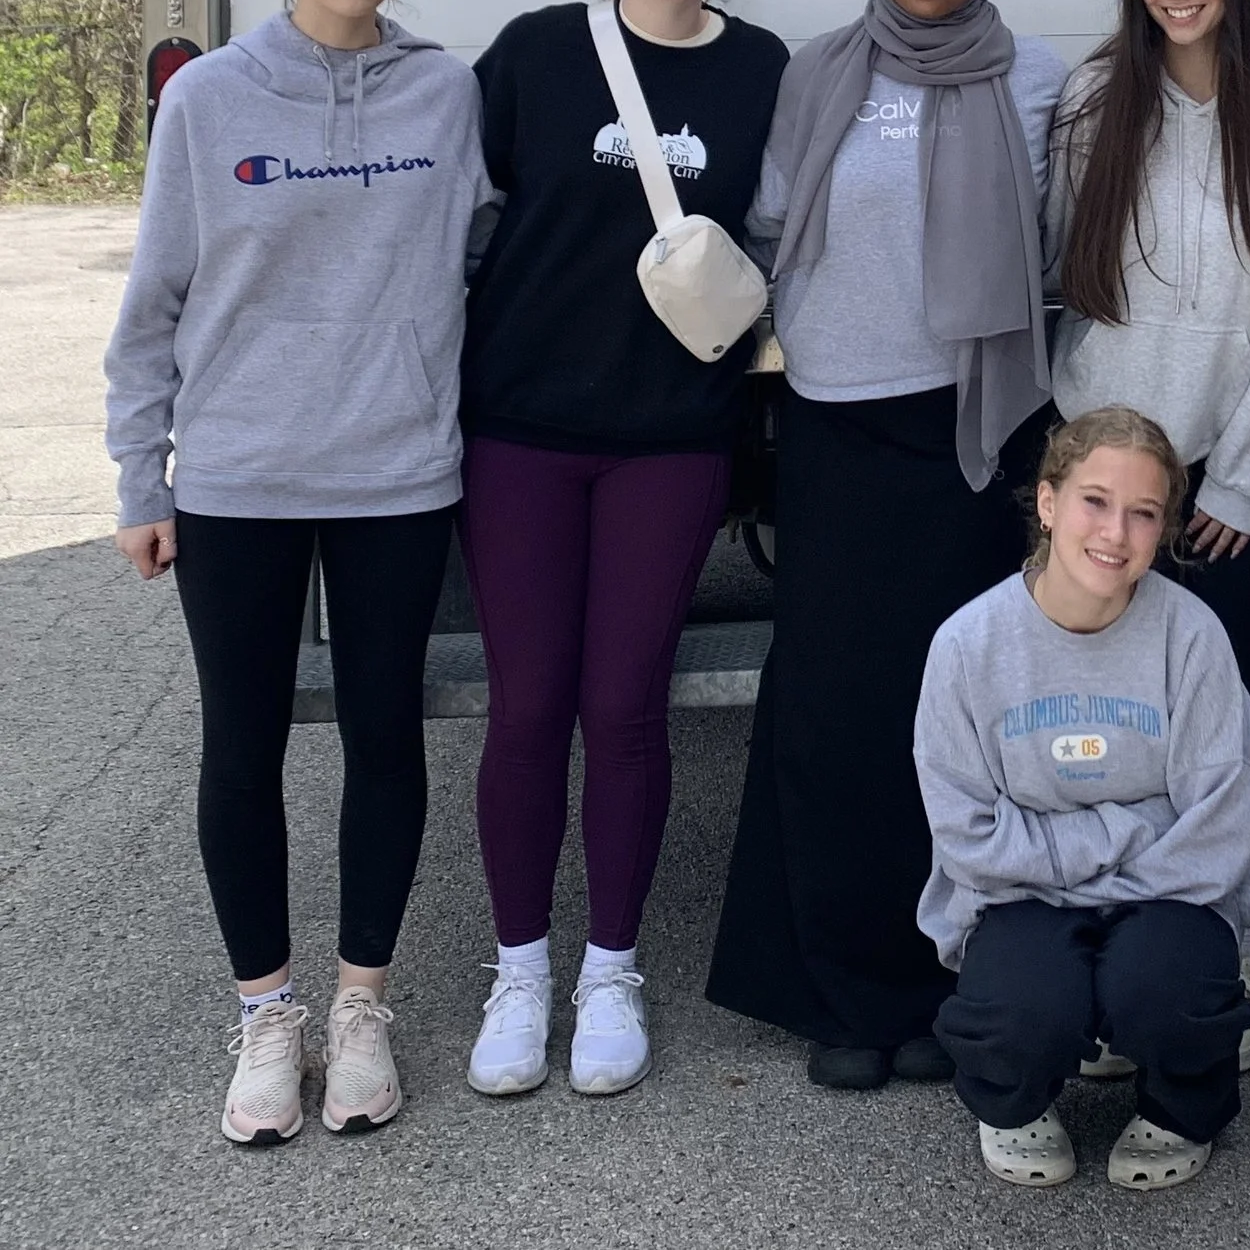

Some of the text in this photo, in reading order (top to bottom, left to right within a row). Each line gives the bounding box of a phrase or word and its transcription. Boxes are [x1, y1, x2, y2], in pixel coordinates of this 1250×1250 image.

[855, 96, 921, 122] Calv
[234, 154, 435, 188] Champion
[593, 151, 621, 166] CITY
[673, 165, 702, 180] CITY
[1084, 693, 1162, 738] JUNCTION
